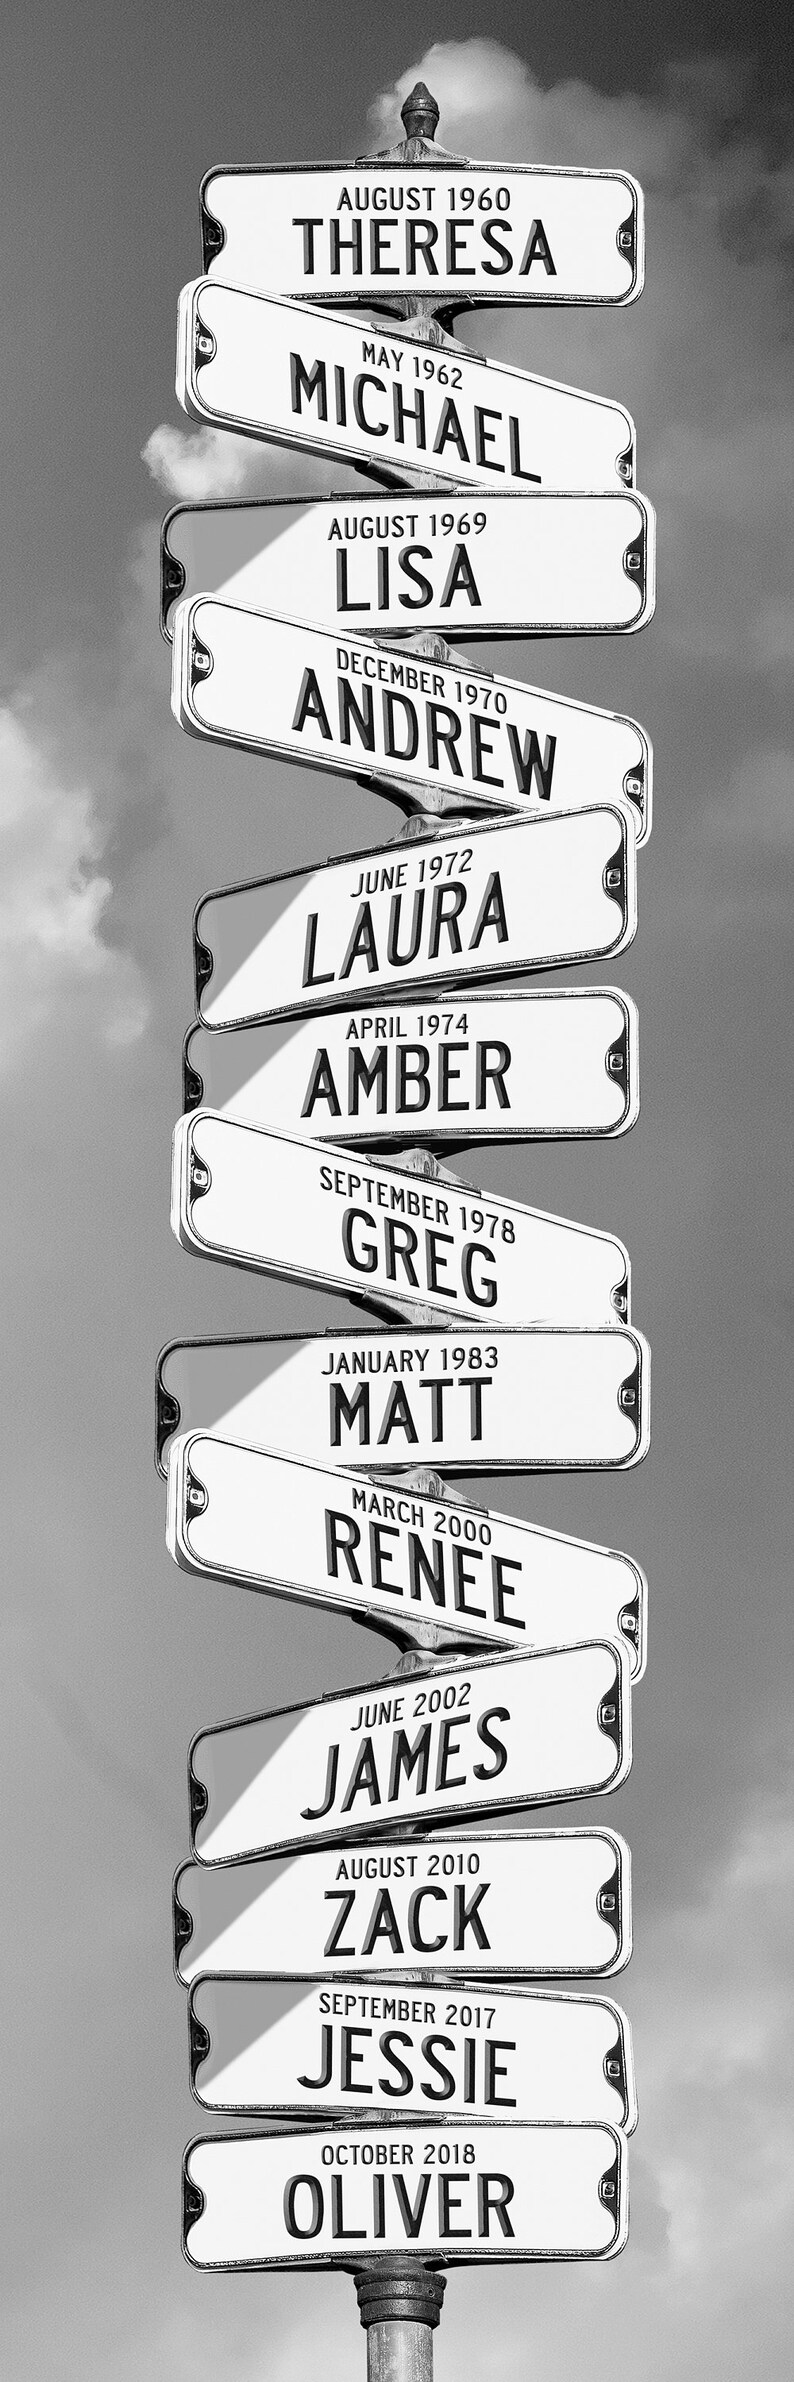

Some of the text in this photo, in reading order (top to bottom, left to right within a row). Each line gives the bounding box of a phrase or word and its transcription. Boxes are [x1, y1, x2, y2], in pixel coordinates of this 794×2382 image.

[337, 187, 510, 211] AUGUST 1960
[292, 219, 557, 275] THERESA
[363, 341, 462, 390] MAY 1962
[290, 352, 541, 483] MICHAEL
[328, 512, 486, 540] AUGUST 1969
[337, 544, 481, 612] LISA
[337, 648, 507, 714] DECEMBER 1970
[292, 667, 556, 801] ANDREW
[350, 849, 473, 897] JUNE 1972
[302, 871, 509, 988] LAURA
[346, 1014, 468, 1039] APRIL 1974
[301, 1041, 511, 1118] AMBER
[320, 1166, 515, 1243] SEPTEMBER 1978
[342, 1208, 497, 1307] GREG
[321, 1346, 498, 1375] JANUARY 1983
[330, 1377, 492, 1446] MATT
[352, 1488, 491, 1545] MARCH 2000
[325, 1509, 525, 1630] RENEE
[350, 1683, 471, 1731] JUNE 2002
[300, 1707, 510, 1820] JAMES
[336, 1853, 479, 1880] AUGUST 2010
[324, 1883, 491, 1957] ZACK
[319, 1993, 495, 2028] SEPTEMBER 2017
[297, 2025, 516, 2107] JESSIE
[322, 2144, 475, 2165] OCTOBER 2018
[284, 2173, 515, 2239] OLIVER
